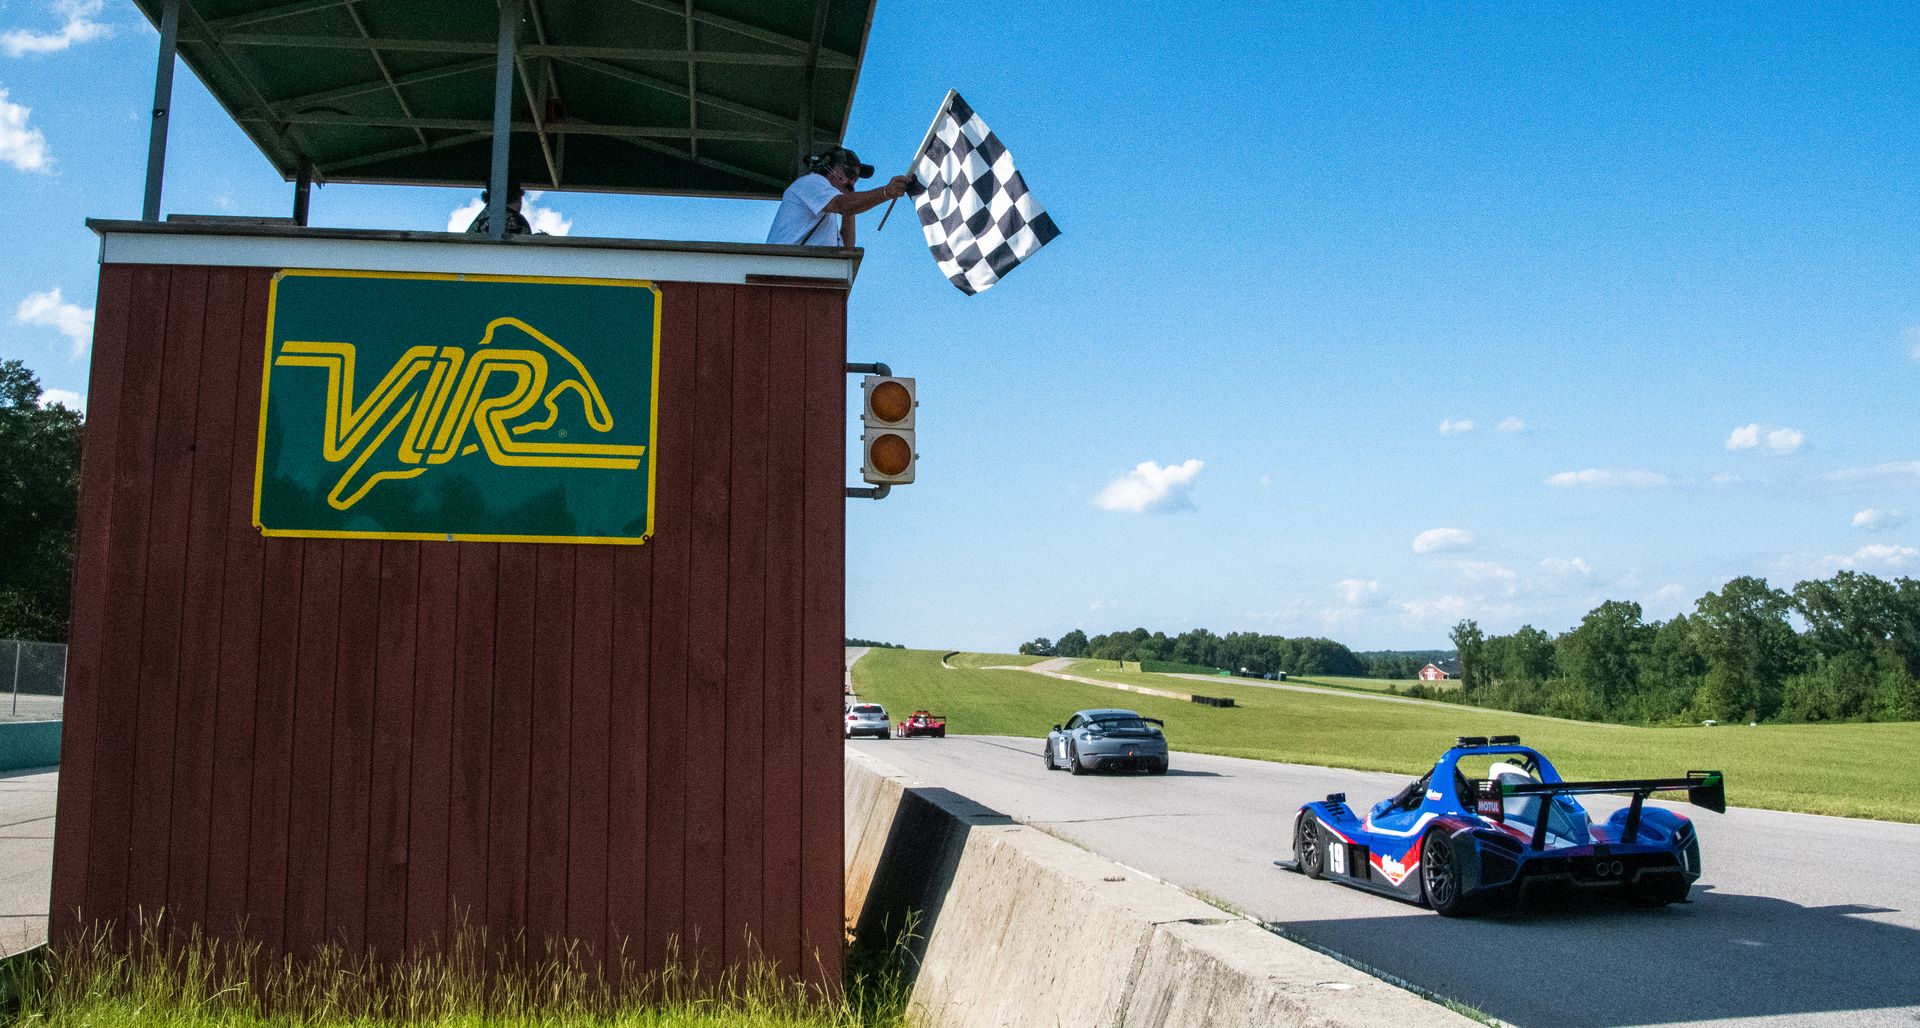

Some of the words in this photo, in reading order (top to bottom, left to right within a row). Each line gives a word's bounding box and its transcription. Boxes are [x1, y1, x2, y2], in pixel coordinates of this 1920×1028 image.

[275, 340, 645, 470] VIR
[1478, 800, 1499, 812] MOTUL
[1329, 842, 1344, 873] 19
